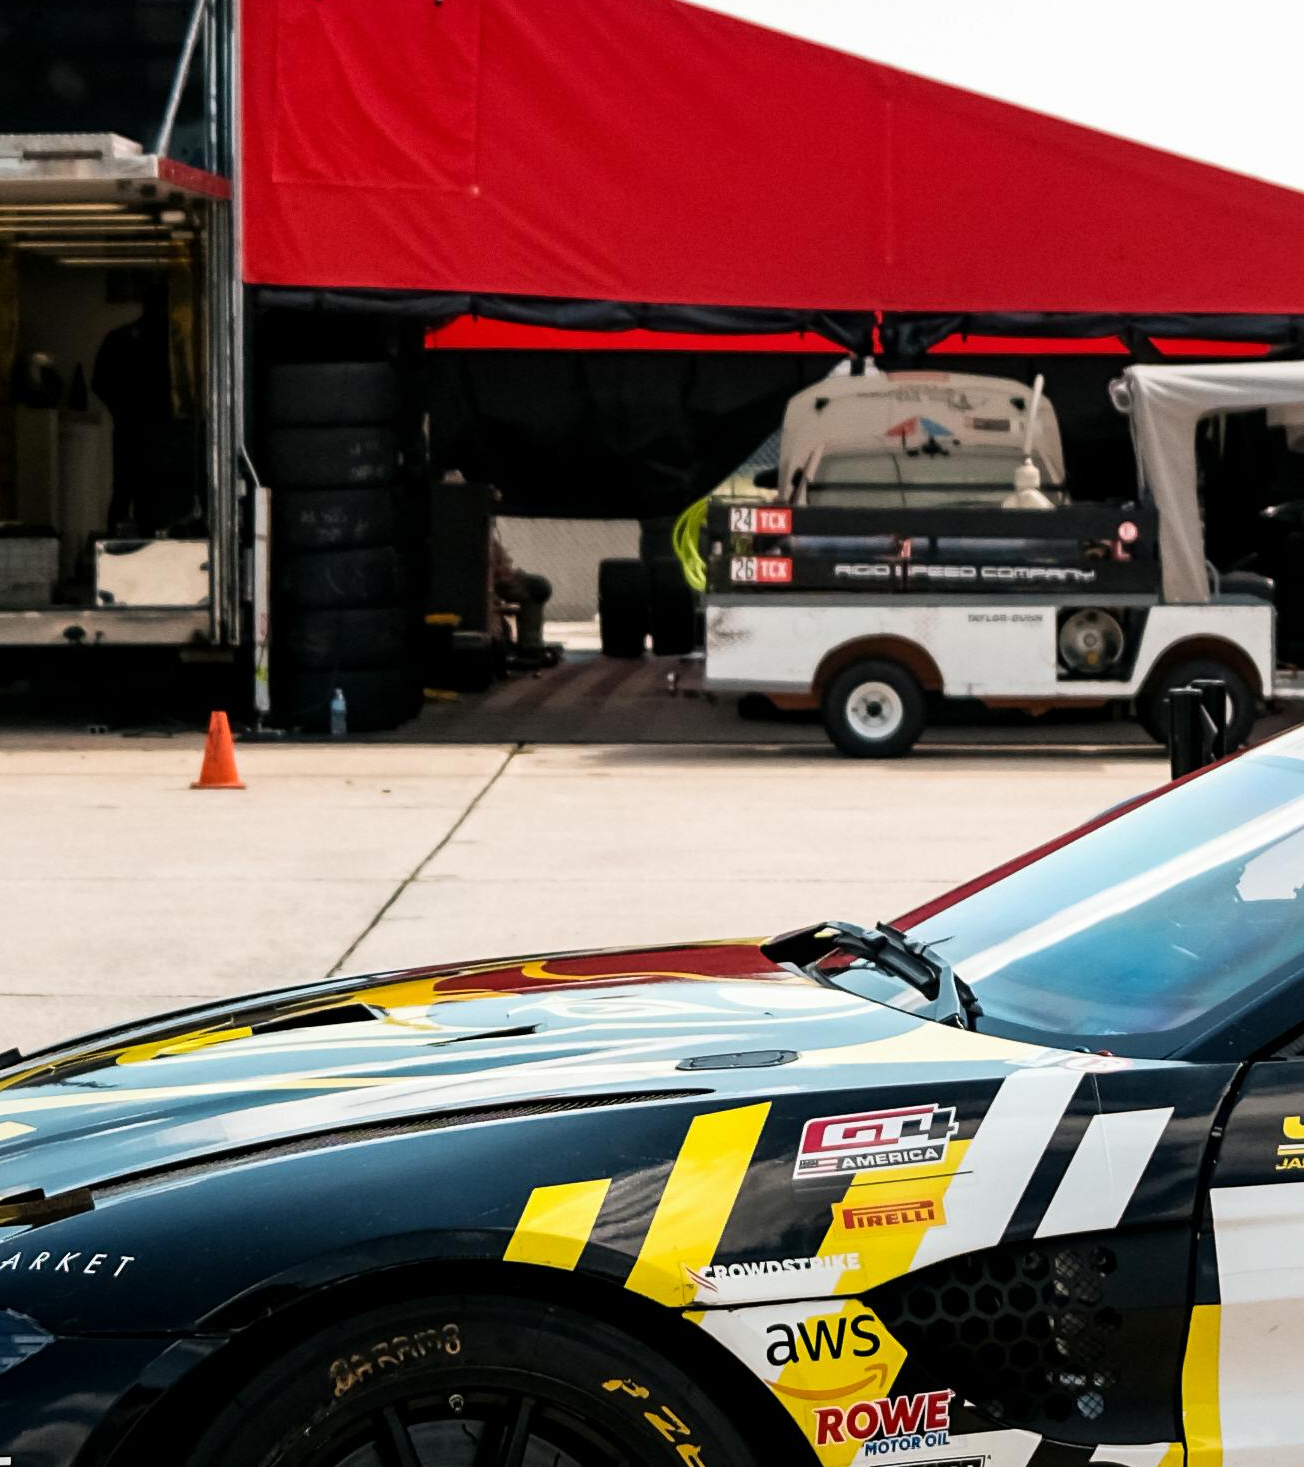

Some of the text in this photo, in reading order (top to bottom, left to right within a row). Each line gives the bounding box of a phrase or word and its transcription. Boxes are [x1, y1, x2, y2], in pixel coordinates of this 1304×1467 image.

[731, 509, 787, 532] 24 TCX
[759, 560, 787, 578] TCX
[981, 567, 1095, 581] COMPANY
[802, 1106, 955, 1154] GT4
[841, 1148, 939, 1169] AMERICA
[842, 1200, 935, 1229] PIRELLI
[700, 1252, 861, 1281] CROWDSTRIKE
[765, 1314, 882, 1367] aws
[814, 1389, 956, 1446] ROWE
[863, 1431, 951, 1457] MOTOR OIL
